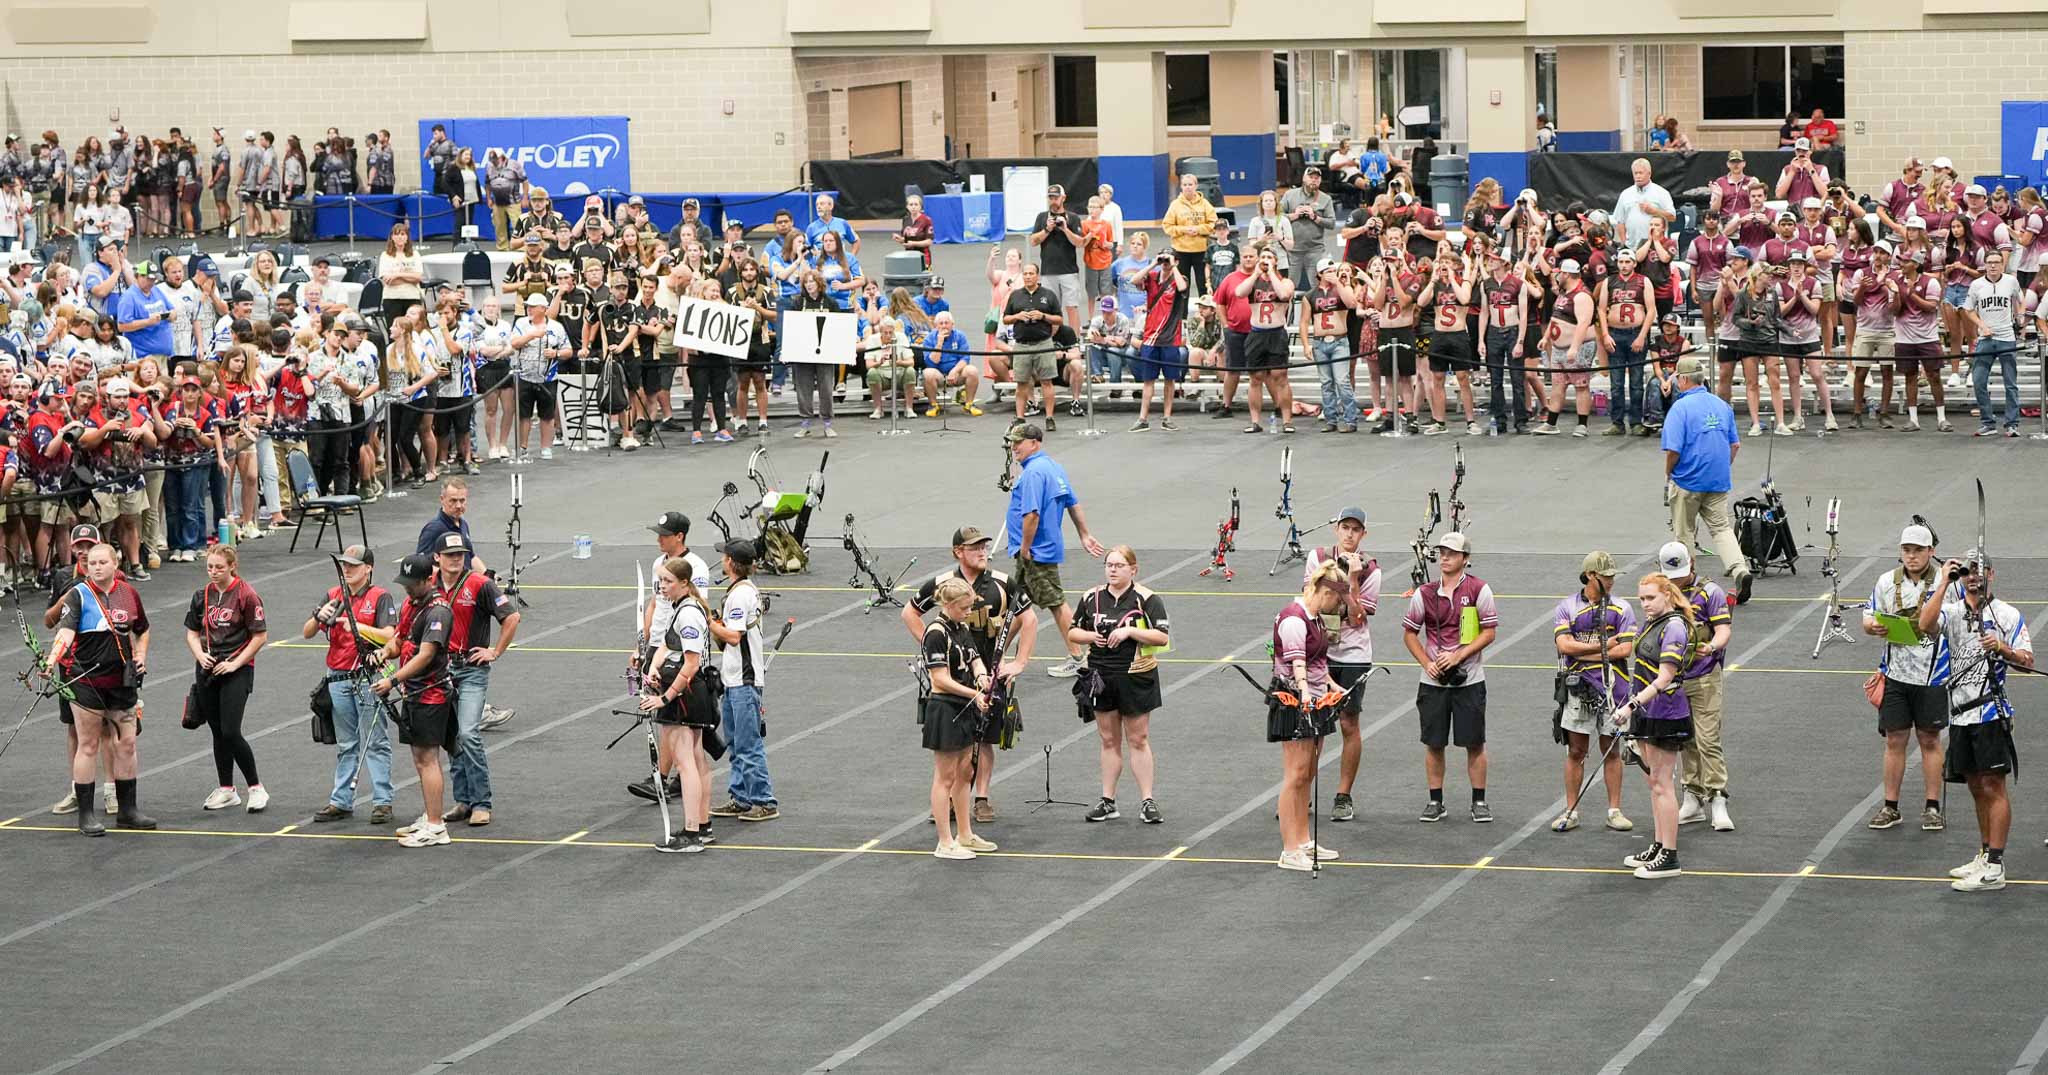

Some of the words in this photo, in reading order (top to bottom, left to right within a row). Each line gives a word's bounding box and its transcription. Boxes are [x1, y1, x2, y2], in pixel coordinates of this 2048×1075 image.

[516, 144, 612, 168] FOLEY
[560, 300, 583, 321] LU
[1259, 303, 1275, 324] R
[1387, 302, 1401, 320] D
[1619, 303, 1636, 323] R
[1981, 296, 2009, 309] UPIKE
[682, 303, 749, 347] LIONS
[1320, 310, 1335, 330] E
[1440, 304, 1457, 327] S
[1493, 303, 1511, 327] T
[815, 316, 827, 355] !
[997, 624, 1008, 651] HOYT
